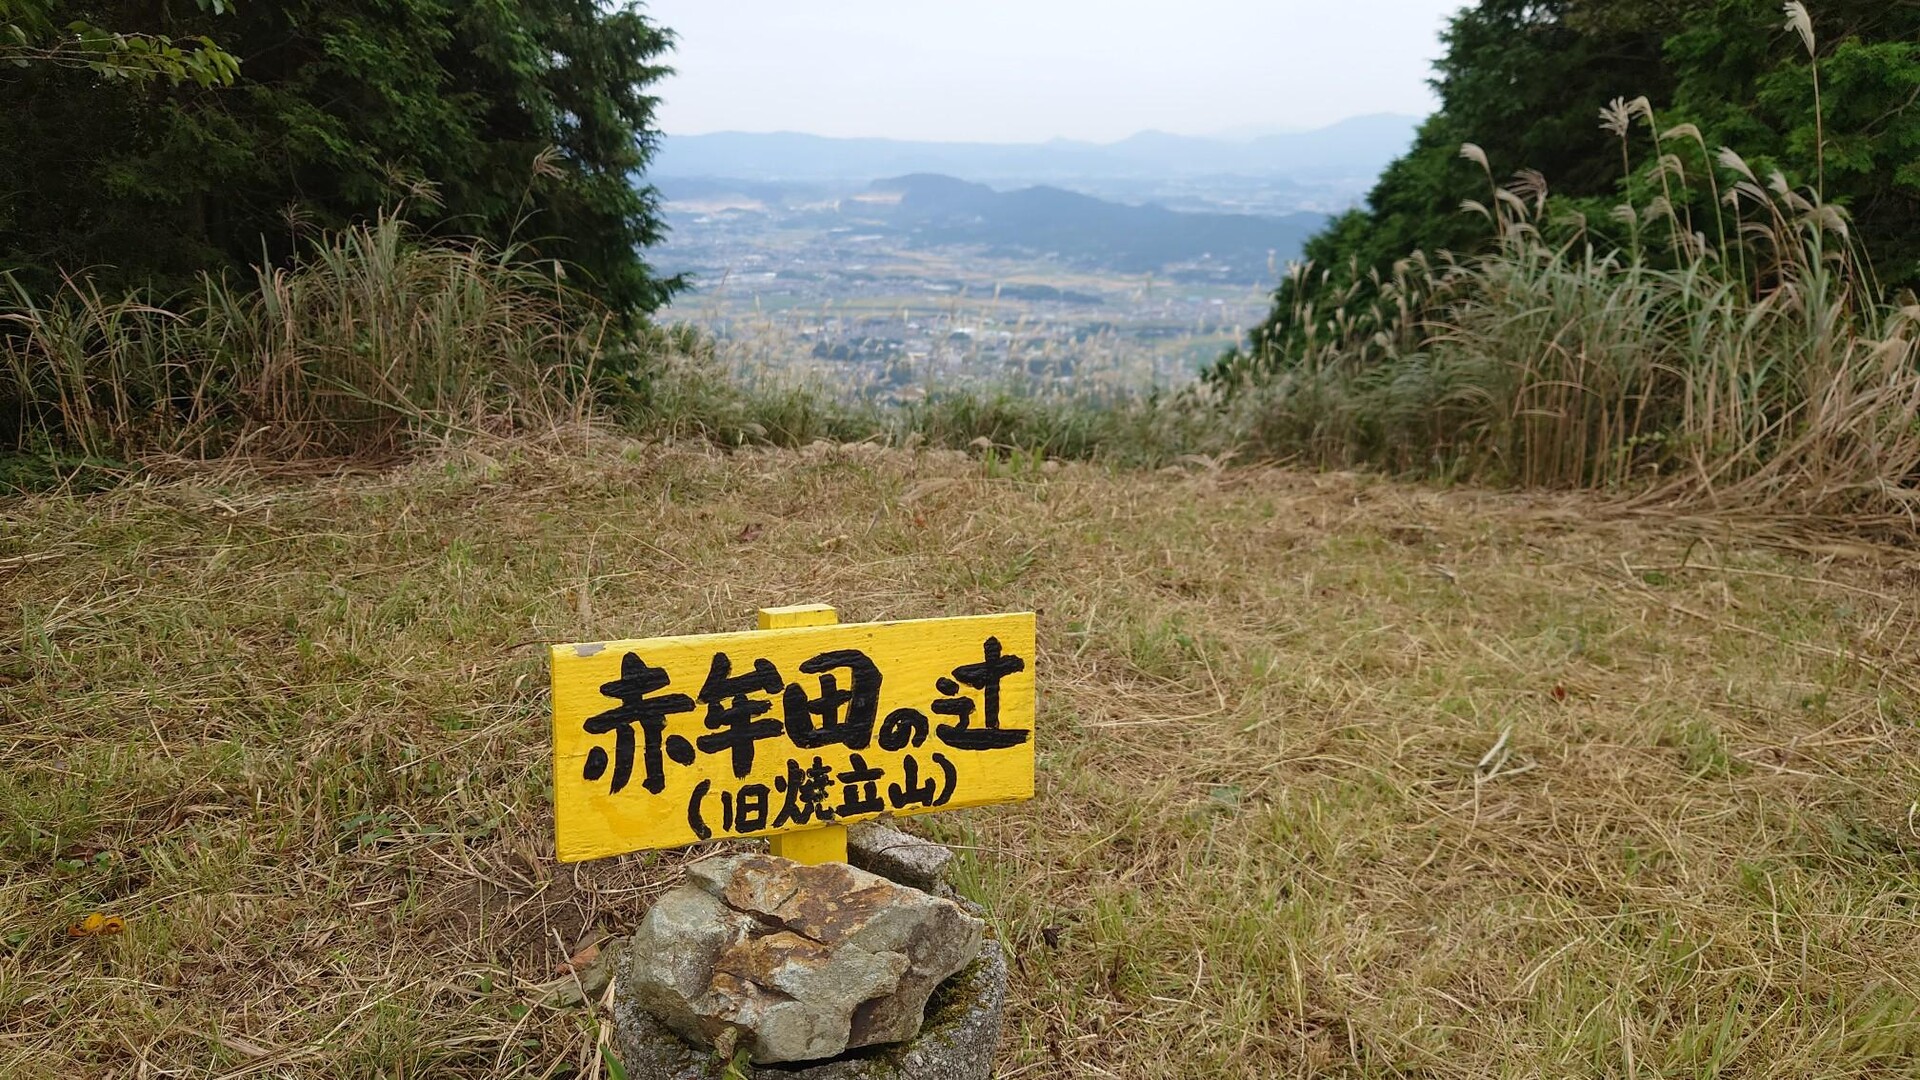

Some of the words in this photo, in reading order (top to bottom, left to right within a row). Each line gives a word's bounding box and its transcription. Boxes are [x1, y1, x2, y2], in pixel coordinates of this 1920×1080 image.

[582, 635, 1031, 795] 赤牟田の辻
